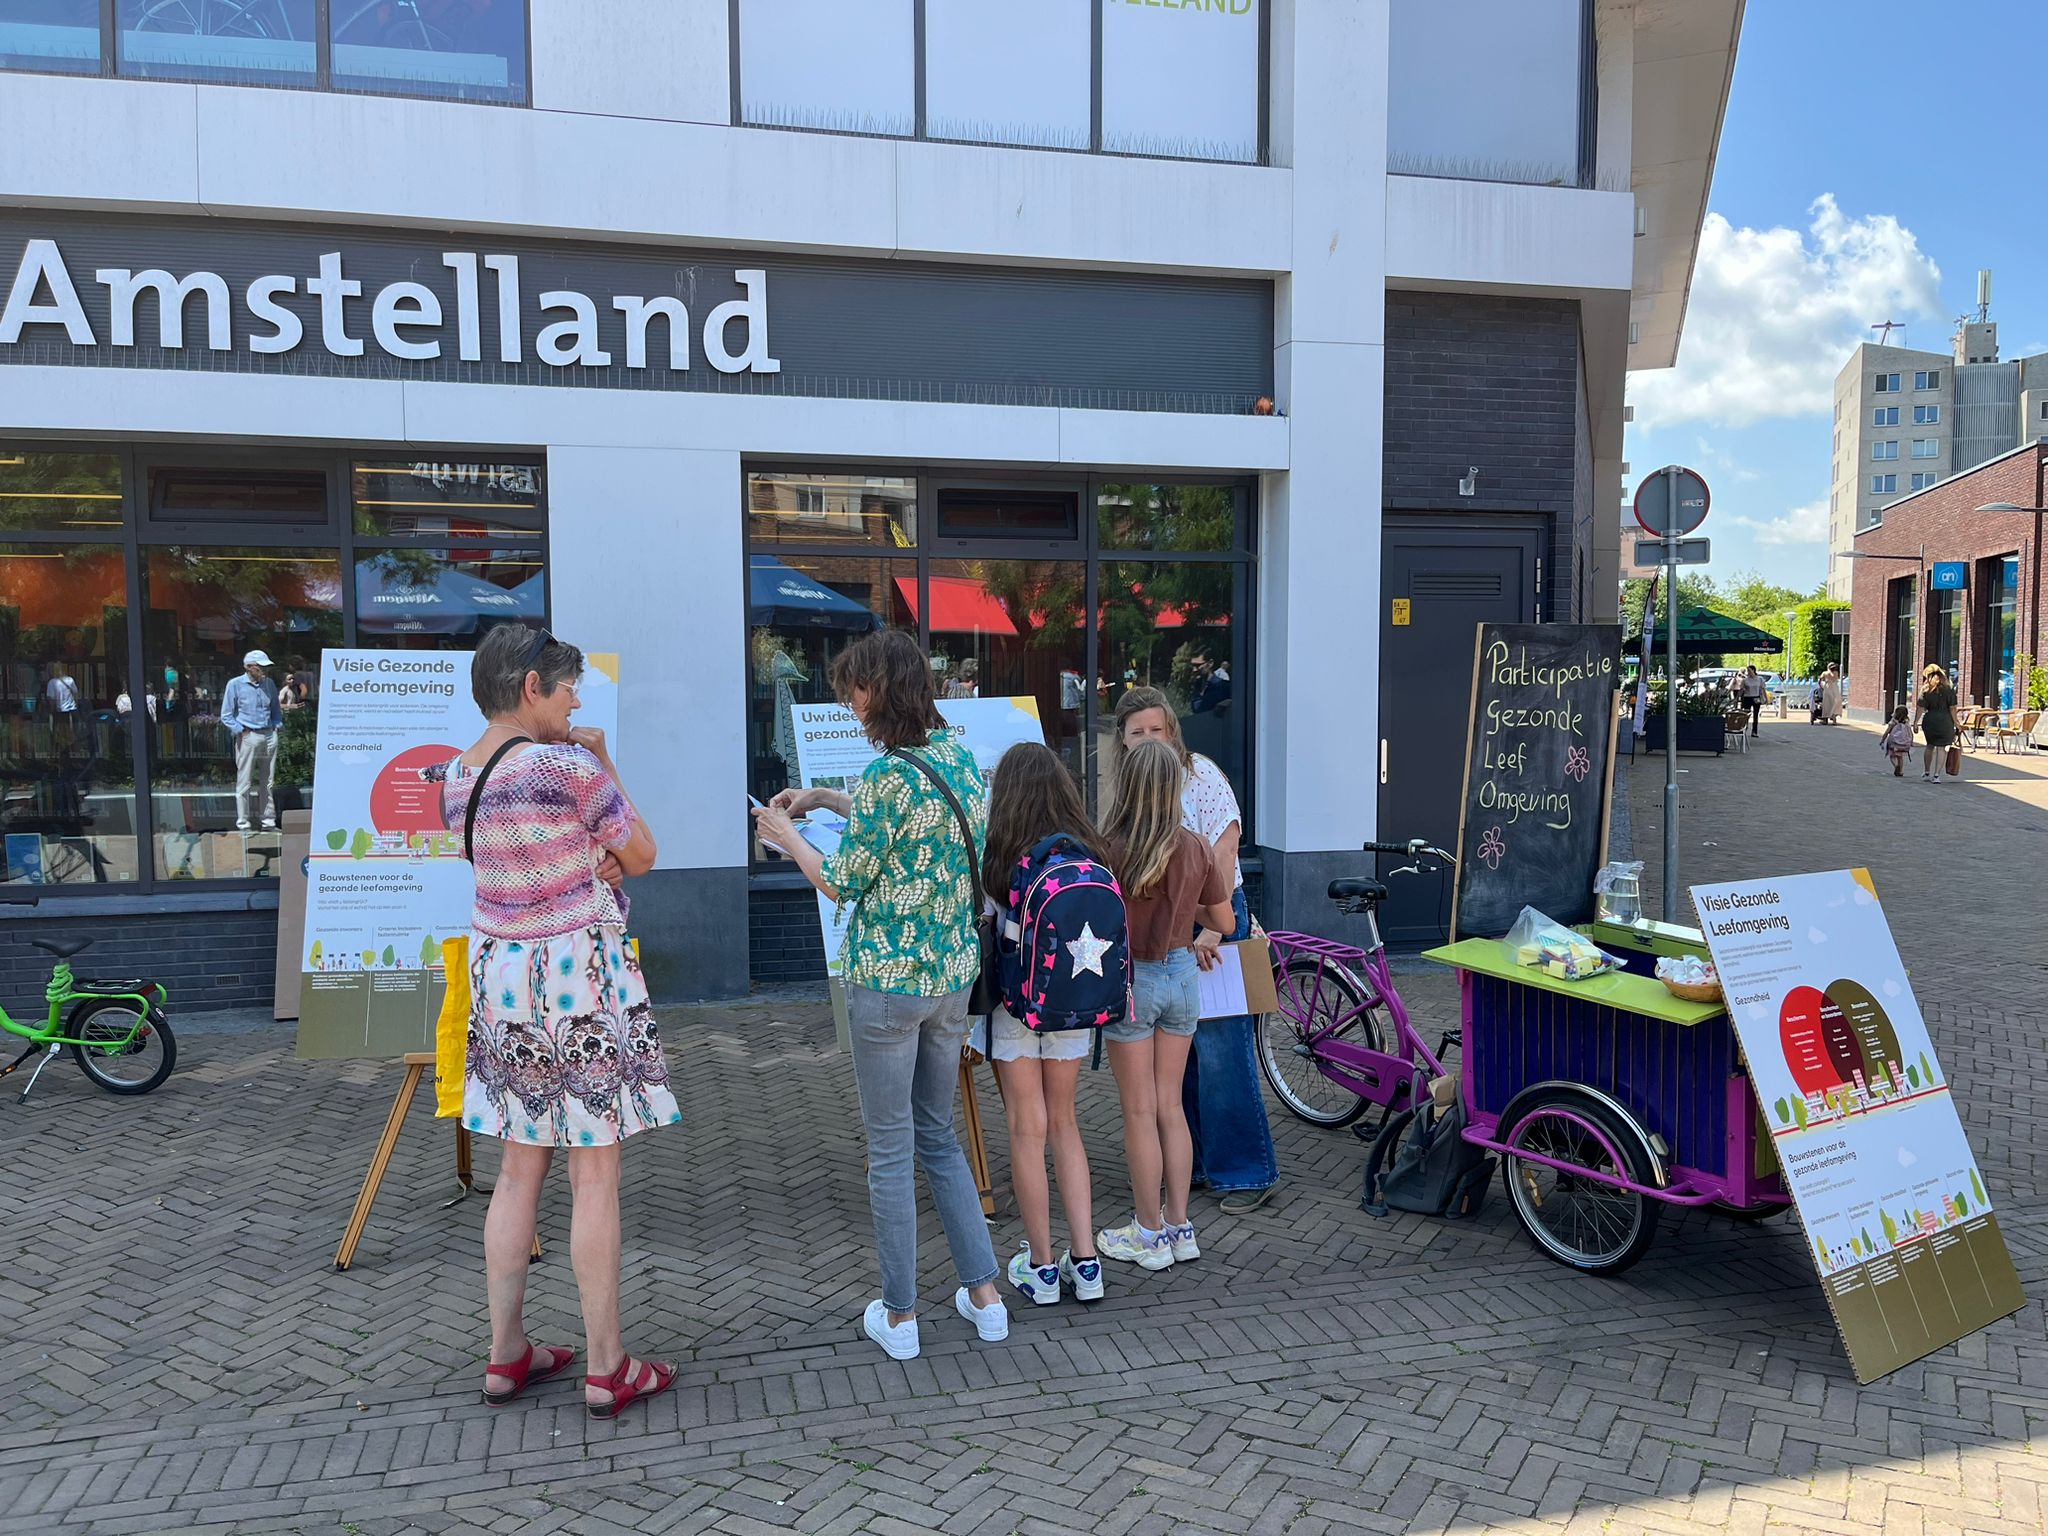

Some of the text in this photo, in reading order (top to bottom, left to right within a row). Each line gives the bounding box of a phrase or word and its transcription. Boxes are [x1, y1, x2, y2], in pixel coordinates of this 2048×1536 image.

[0, 239, 780, 374] Amstelland
[332, 658, 455, 673] Visie Gezonde
[1486, 640, 1612, 699] Participatie
[331, 679, 455, 697] Leefomgeving
[801, 710, 859, 723] Uw idee
[804, 727, 867, 742] gezonde
[327, 743, 382, 751] Gezondheid
[1484, 741, 1527, 776] Leef
[1479, 780, 1571, 830] Omgeving
[319, 873, 378, 882] Bouwstenen
[402, 873, 414, 881] de
[318, 883, 423, 894] gezonde leefomgeving
[1700, 889, 1780, 912] Visie Gezonde
[1709, 913, 1790, 937] Leefomgeving
[1735, 992, 1770, 1005] Gezondheid
[1788, 1140, 1847, 1163] Bouwstenen voor de
[1793, 1151, 1857, 1178] gezonde leefomgeving
